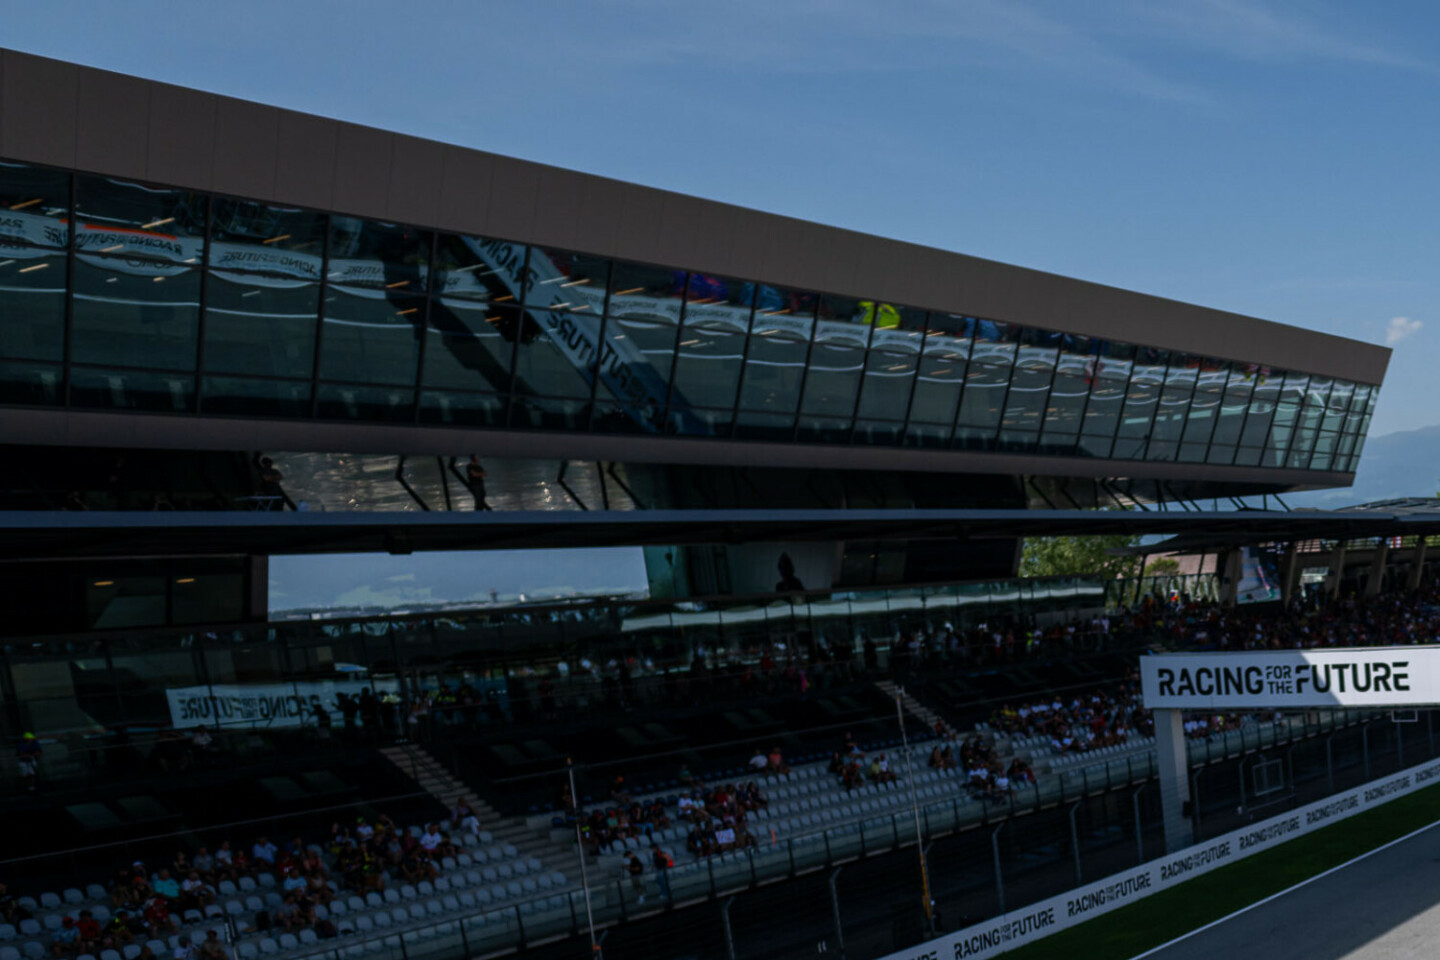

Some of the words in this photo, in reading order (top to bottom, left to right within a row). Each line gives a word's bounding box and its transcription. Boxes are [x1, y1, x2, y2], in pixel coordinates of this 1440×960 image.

[1157, 666, 1263, 696] RACING
[1265, 665, 1291, 679] FOR
[1267, 681, 1293, 694] THE
[1295, 661, 1410, 693] FUTURE
[1160, 856, 1194, 880] RACING
[1200, 841, 1231, 863] FUTURE
[1067, 889, 1105, 917] RACING
[1114, 872, 1151, 899] FUTURE
[953, 927, 1001, 960] RACING
[1011, 907, 1055, 939] FUTURE
